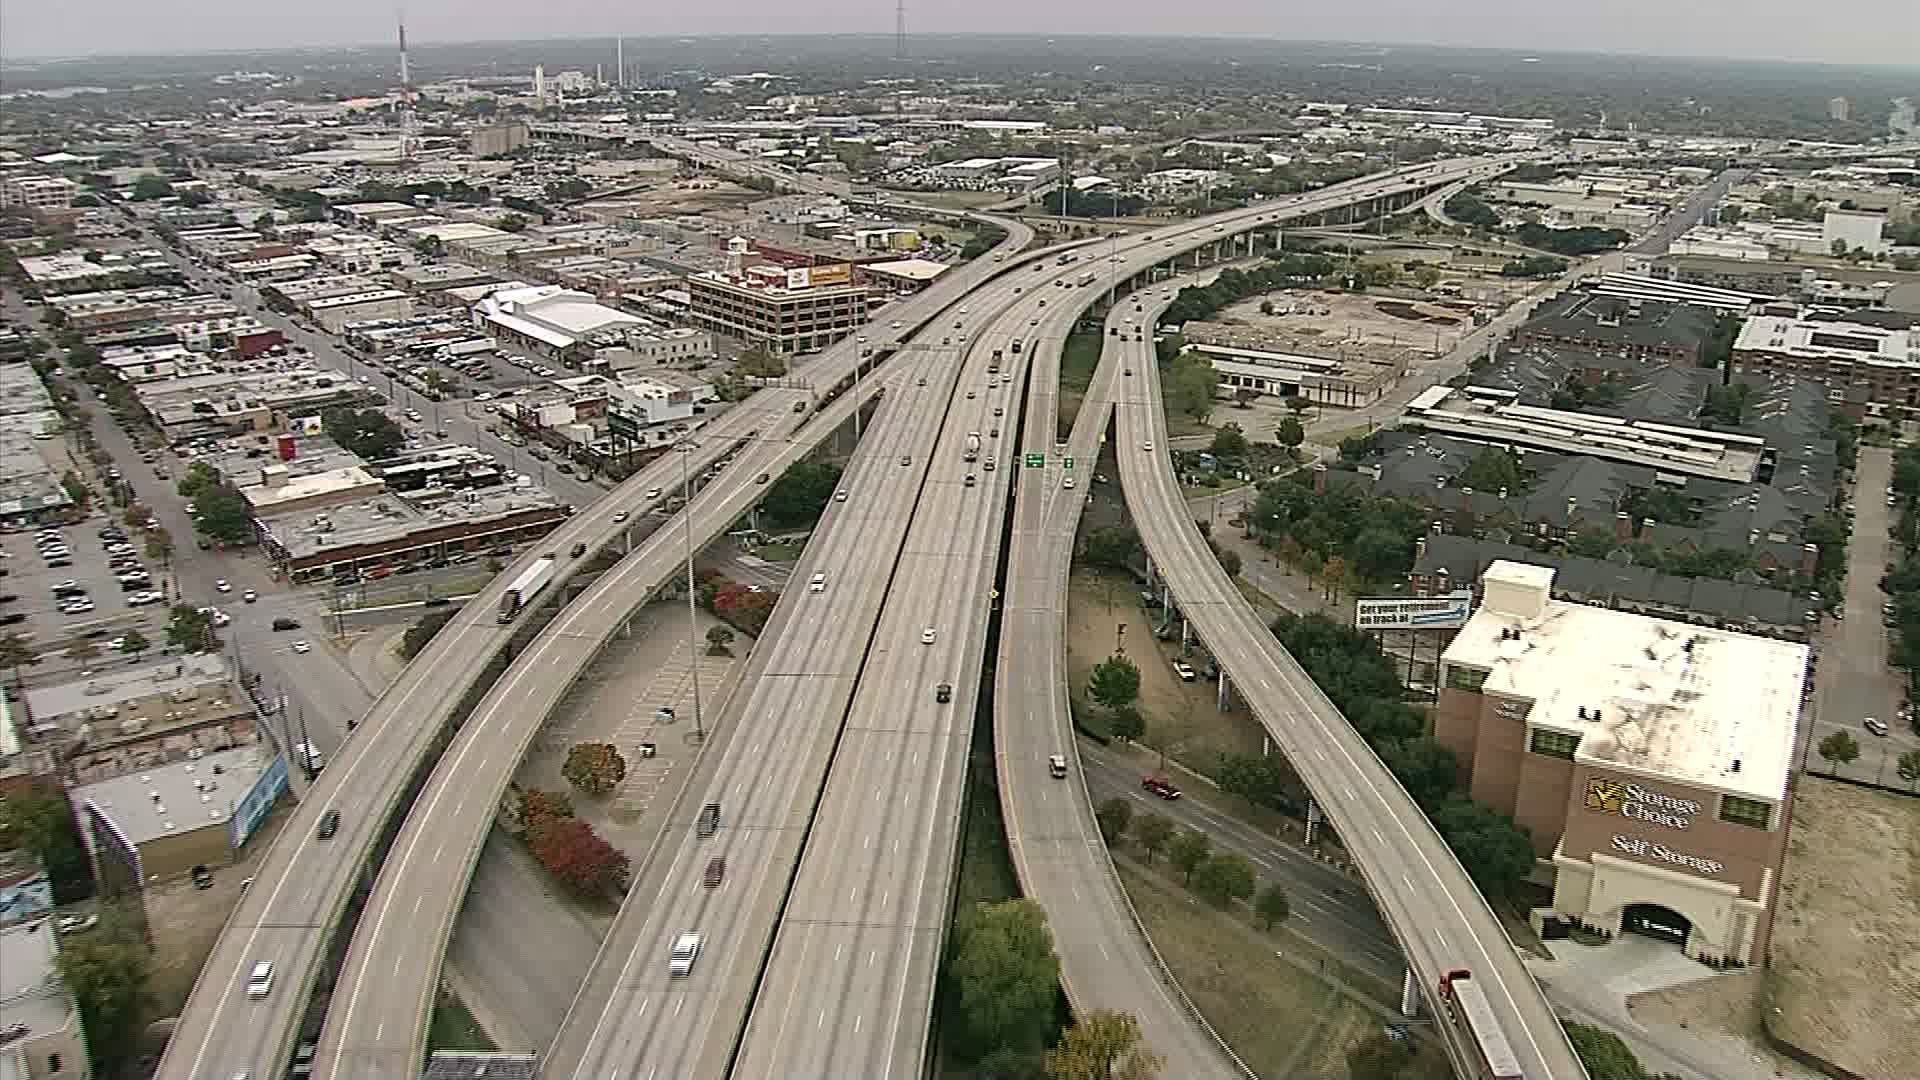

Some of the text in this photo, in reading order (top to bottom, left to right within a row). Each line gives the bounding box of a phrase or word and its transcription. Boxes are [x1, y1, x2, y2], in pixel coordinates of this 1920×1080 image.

[1360, 603, 1449, 614] Get your retirement
[1360, 614, 1371, 624] on
[1372, 613, 1396, 623] track
[1623, 783, 1701, 815] Storage
[1621, 801, 1689, 829] Choice
[1610, 834, 1725, 873] Self Storage
